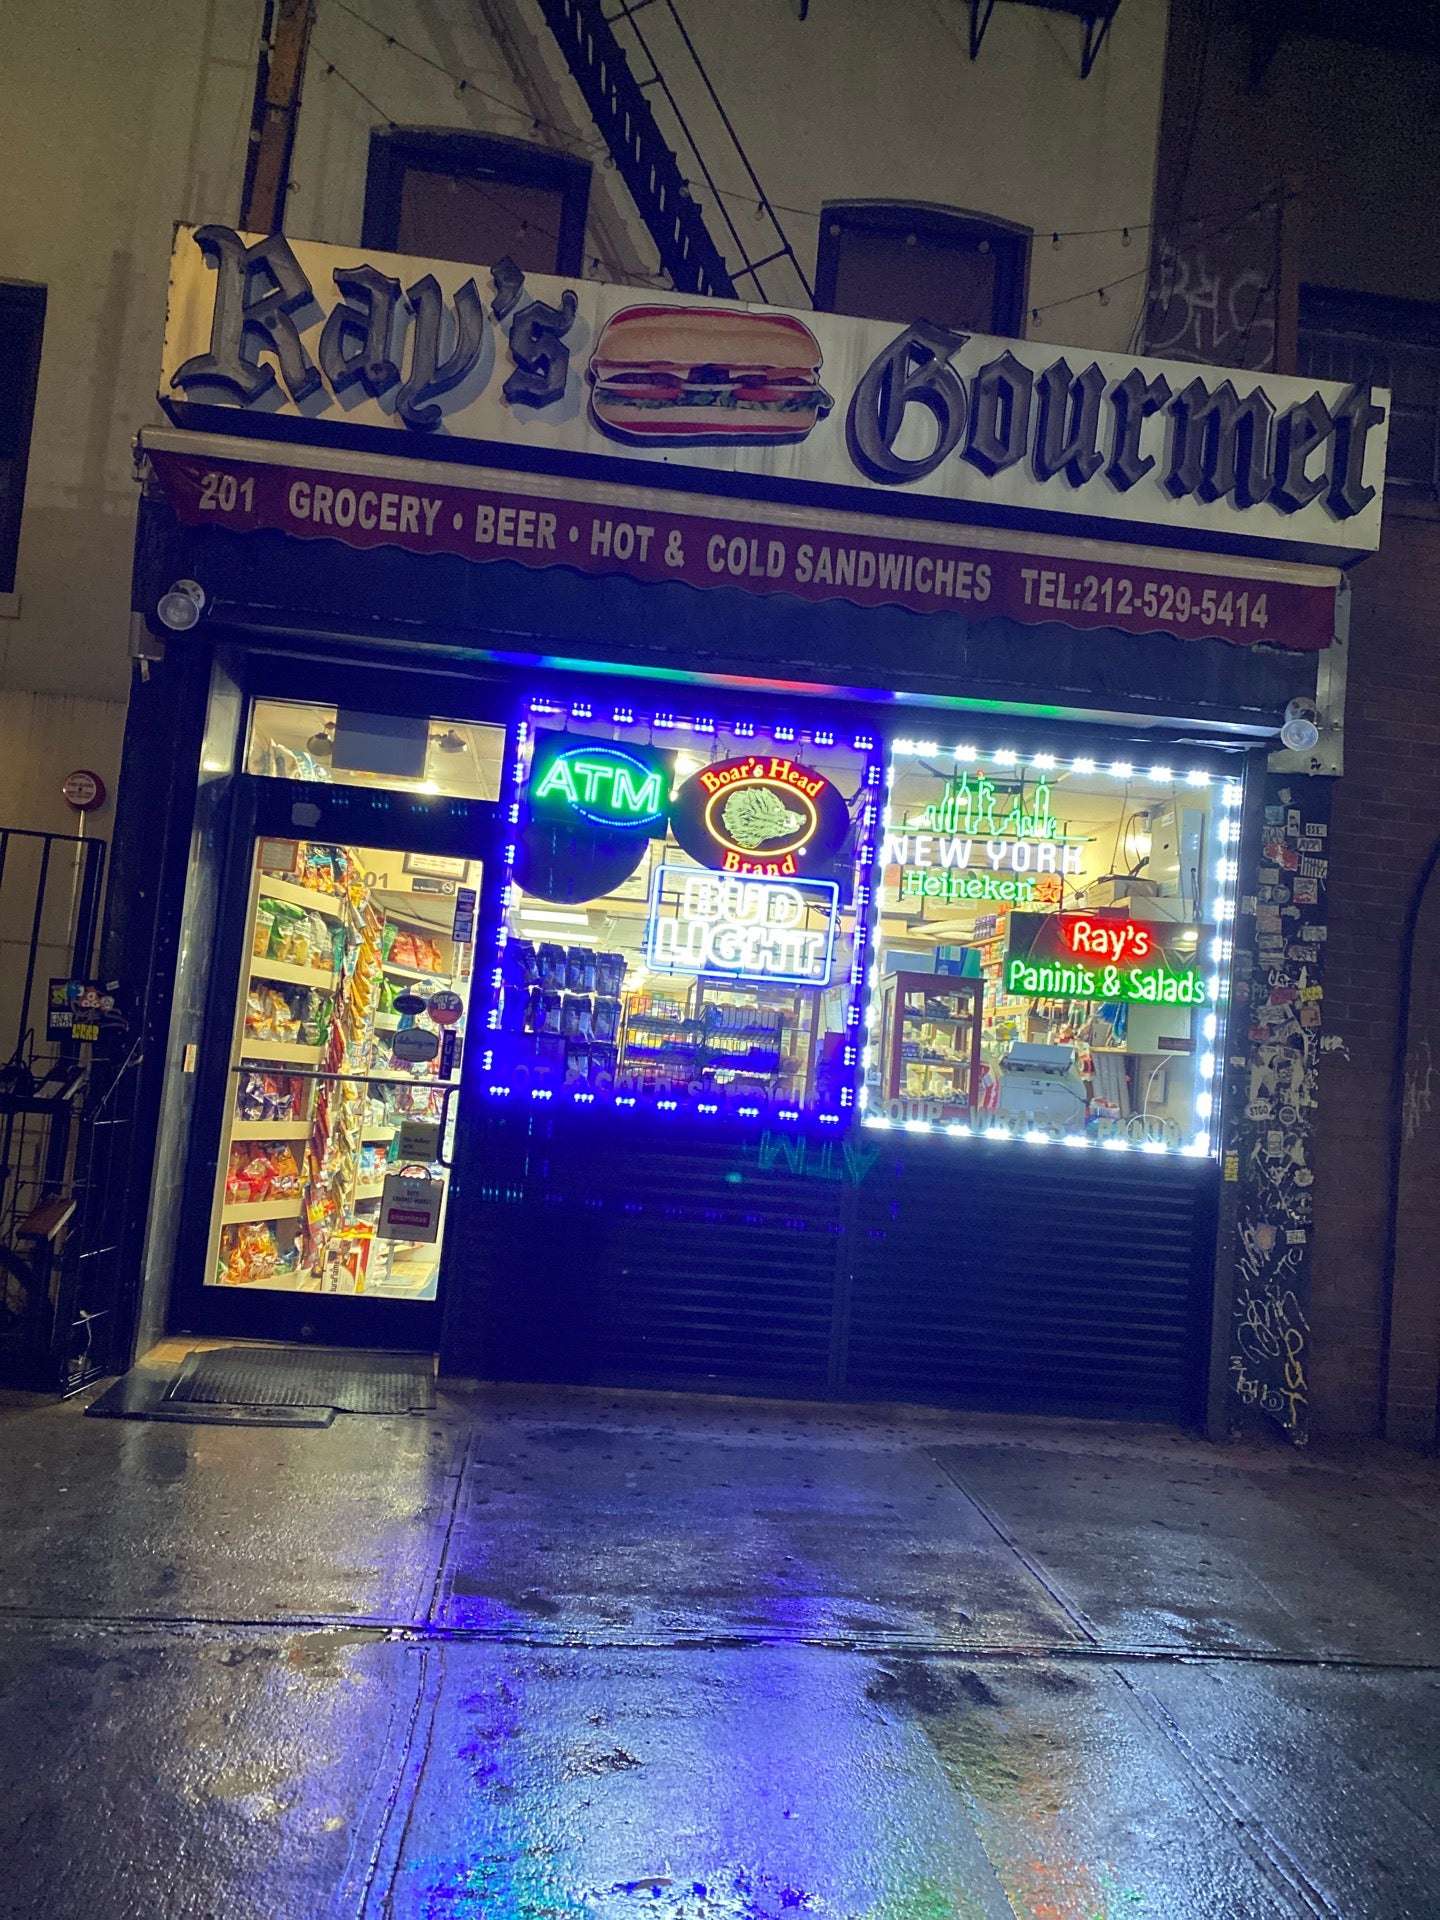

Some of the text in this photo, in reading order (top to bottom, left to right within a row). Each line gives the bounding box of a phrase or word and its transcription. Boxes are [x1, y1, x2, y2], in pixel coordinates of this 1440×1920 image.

[170, 223, 1386, 521] Ray's Gourmet
[198, 473, 1269, 630] 201 GROCERY BEER HOT & COLD SANDWICHES TEL:212-529-5414
[536, 759, 663, 813] ATM
[700, 757, 825, 797] Boar's Head
[723, 851, 797, 876] Brand
[883, 833, 1084, 875] NEW YORK
[347, 871, 389, 889] 201
[903, 870, 1034, 901] Heineken
[683, 876, 805, 930] BUD
[1072, 921, 1150, 962] Ray's
[433, 995, 449, 1003] GOT
[1009, 960, 1206, 1004] Paninis & Salads
[442, 1034, 453, 1076] PULL
[867, 1096, 944, 1125] SOUP
[969, 1105, 1066, 1139] WRAPS
